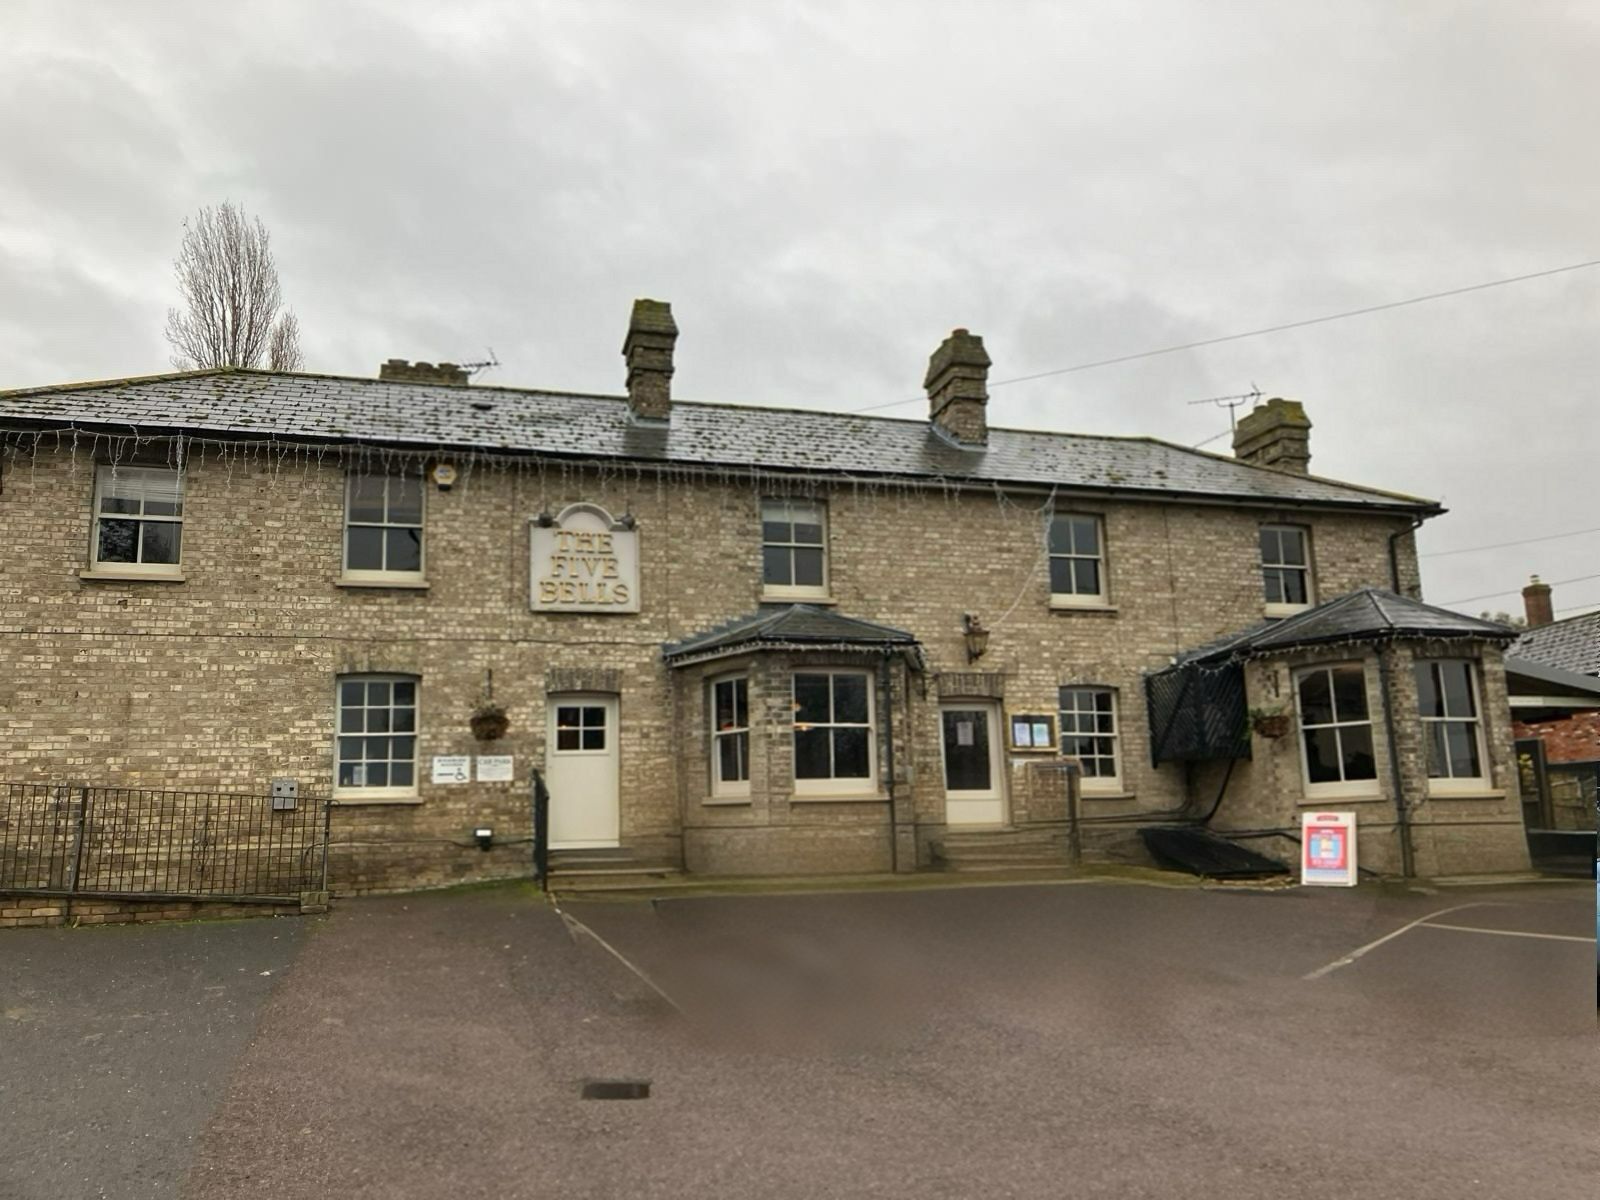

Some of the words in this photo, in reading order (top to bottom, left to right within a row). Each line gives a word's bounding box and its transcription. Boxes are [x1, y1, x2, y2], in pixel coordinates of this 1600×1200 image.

[554, 531, 613, 554] THE
[550, 556, 619, 578] FIVE
[539, 581, 630, 605] BELLS
